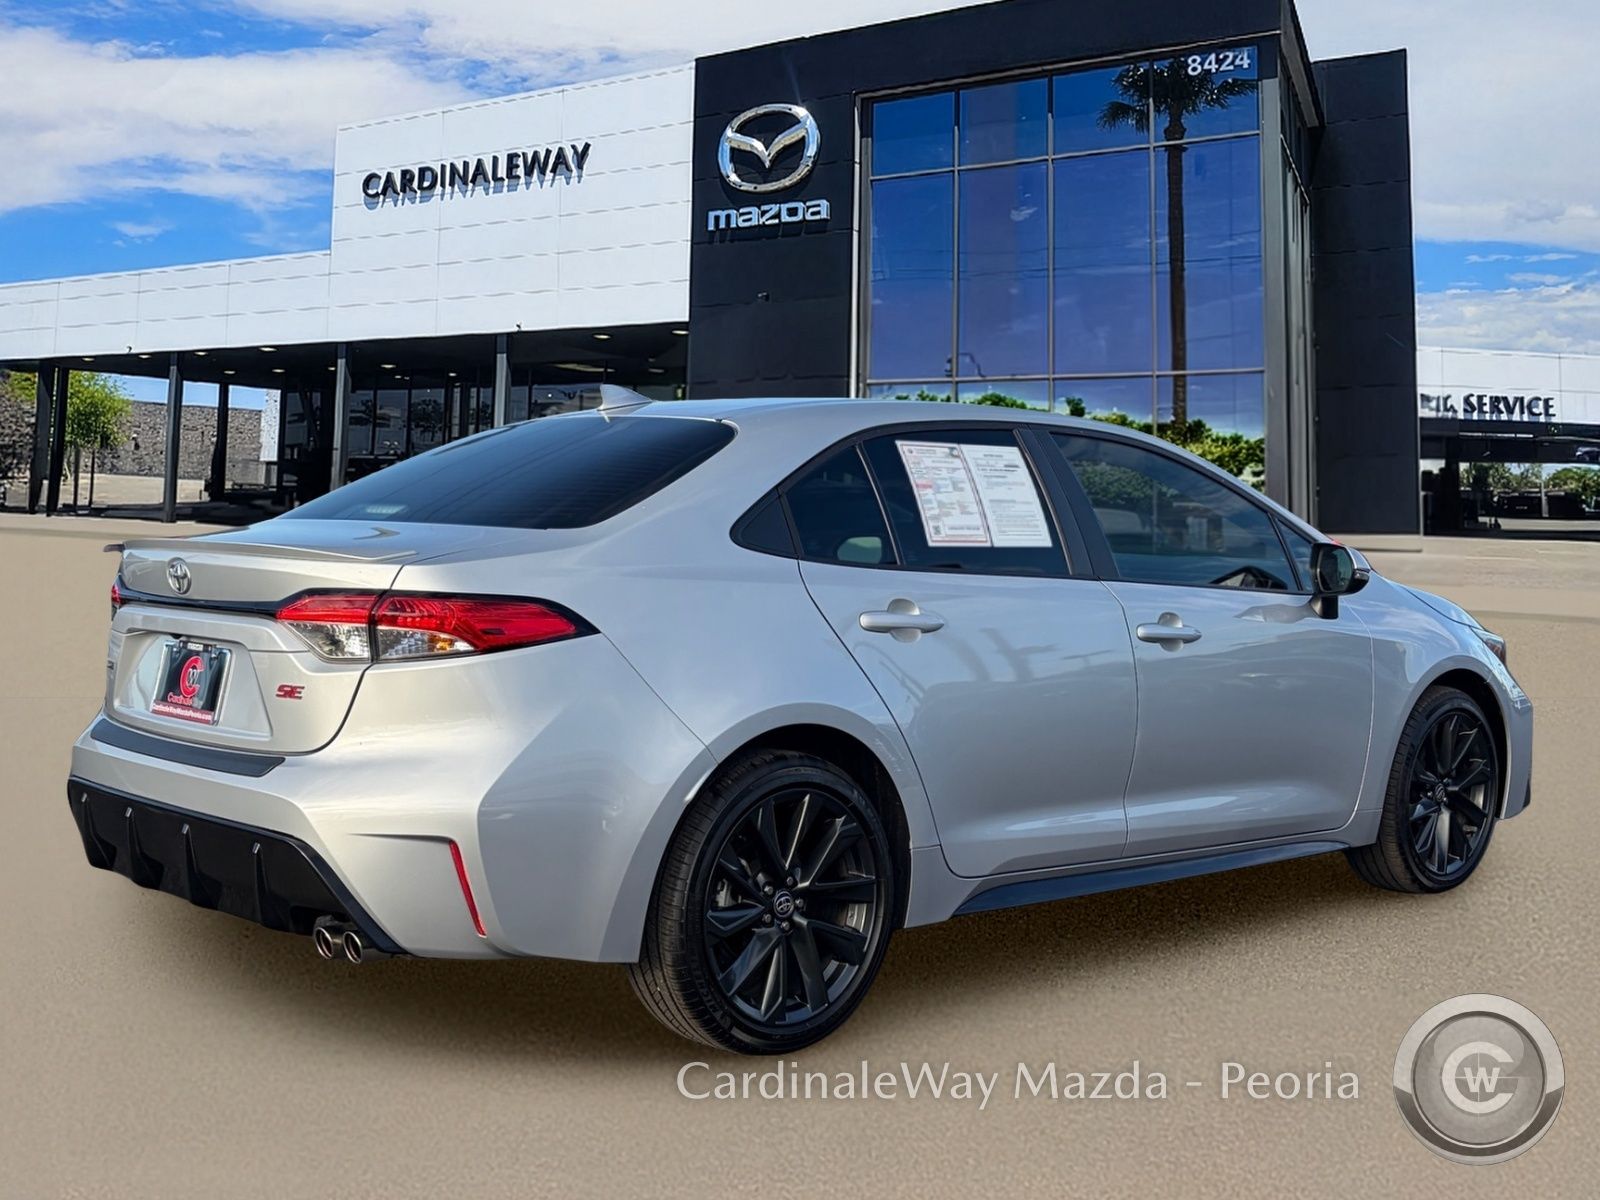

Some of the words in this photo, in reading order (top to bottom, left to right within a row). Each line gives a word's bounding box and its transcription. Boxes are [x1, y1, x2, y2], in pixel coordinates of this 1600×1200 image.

[1187, 49, 1251, 76] 8424
[362, 142, 591, 199] CARDINALEWAY
[707, 199, 830, 231] mazda
[1463, 393, 1556, 417] SERVICE
[276, 684, 305, 700] SE
